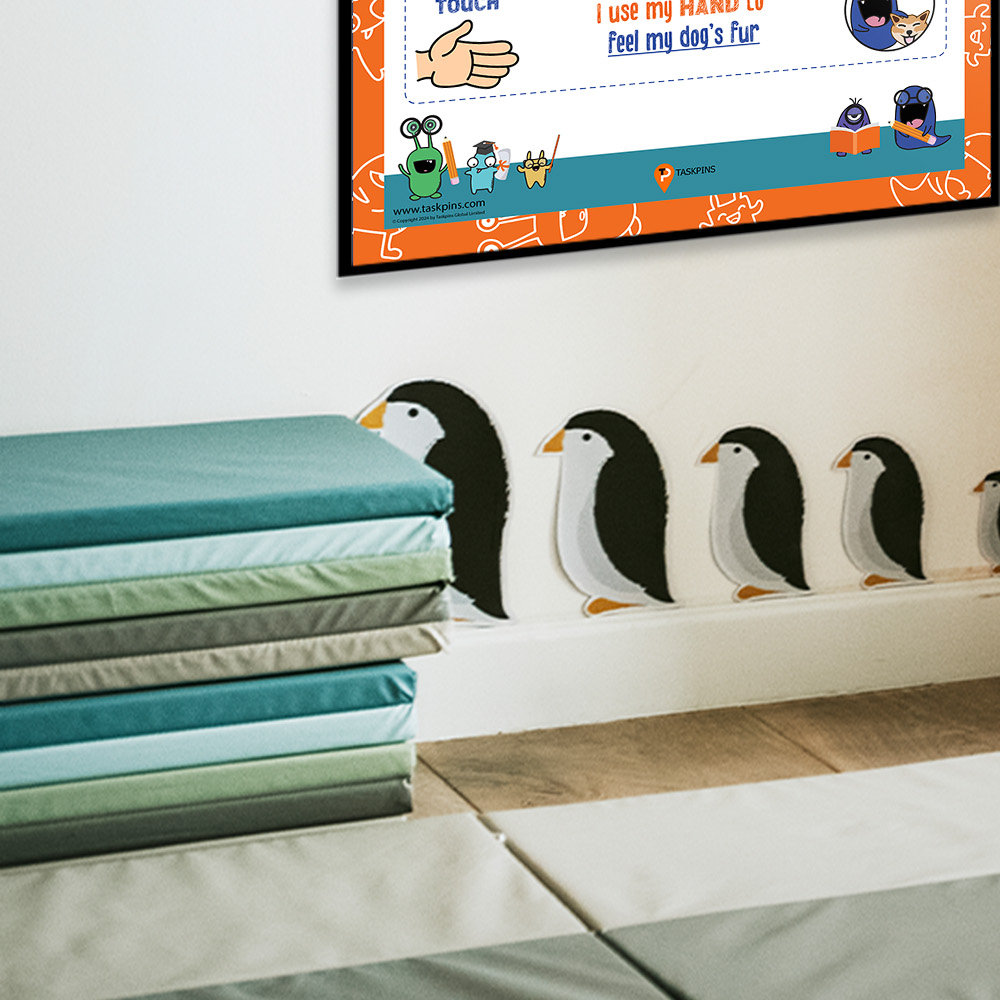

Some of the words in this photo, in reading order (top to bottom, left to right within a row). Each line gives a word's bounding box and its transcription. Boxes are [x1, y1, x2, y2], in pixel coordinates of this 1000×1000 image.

[597, 3, 602, 24] I
[609, 2, 639, 23] use
[646, 0, 672, 23] my
[608, 30, 639, 54] feel
[646, 30, 672, 54] my
[680, 23, 723, 50] dog's
[730, 20, 760, 43] fur
[676, 165, 716, 176] TASKPINS
[393, 200, 486, 215] www.taskpins.com
[396, 216, 418, 224] Copyright
